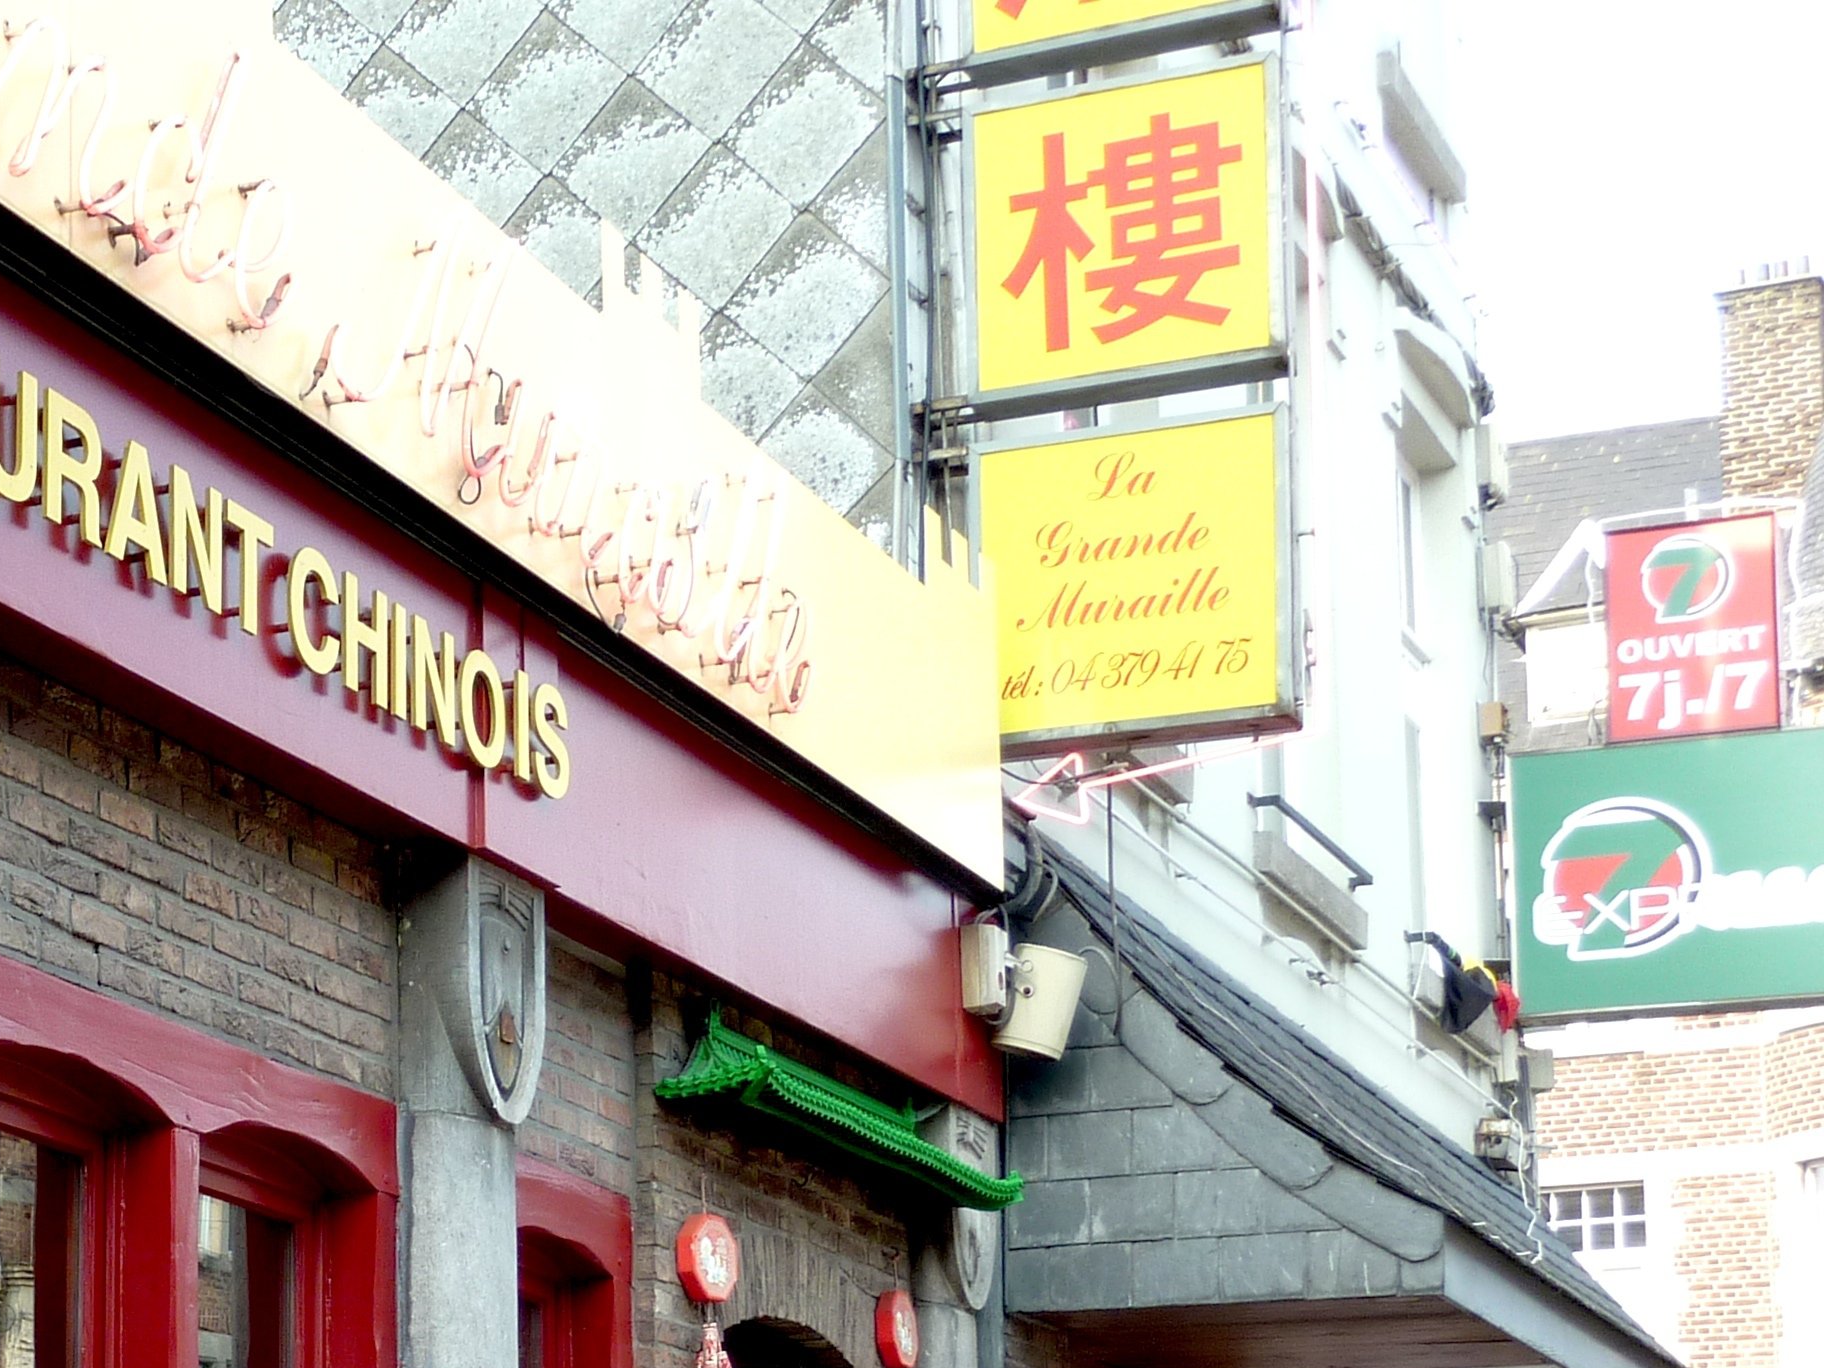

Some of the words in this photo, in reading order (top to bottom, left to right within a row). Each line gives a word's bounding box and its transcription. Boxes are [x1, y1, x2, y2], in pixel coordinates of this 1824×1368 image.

[1001, 112, 1242, 353] 樓
[1088, 451, 1157, 501] La
[1036, 512, 1208, 567] Grande
[1016, 566, 1230, 633] Muraille
[287, 546, 570, 800] CHINOIS
[1617, 627, 1764, 663] OUVERT
